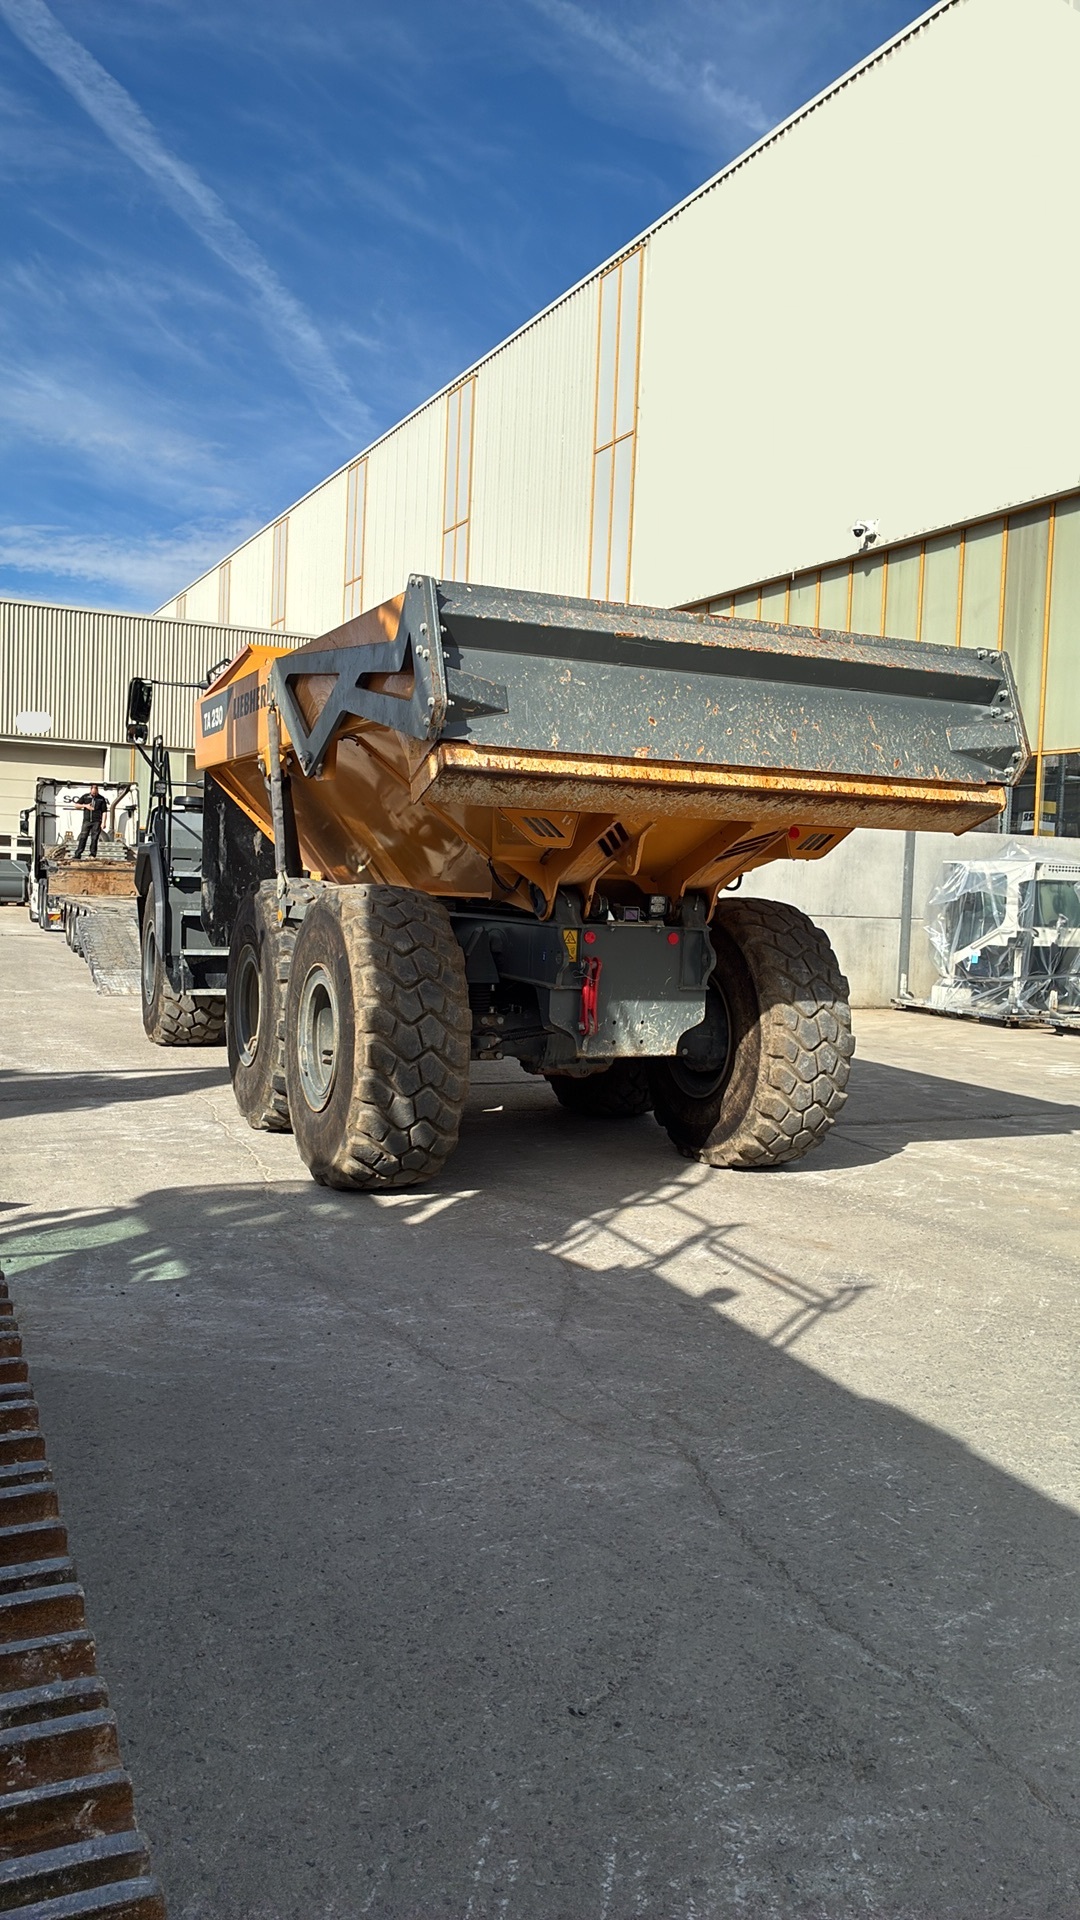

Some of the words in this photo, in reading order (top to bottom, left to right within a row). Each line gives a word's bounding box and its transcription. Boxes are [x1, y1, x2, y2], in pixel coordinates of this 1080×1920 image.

[234, 685, 269, 719] LIEBHER
[204, 712, 211, 731] TA
[212, 705, 223, 728] 230
